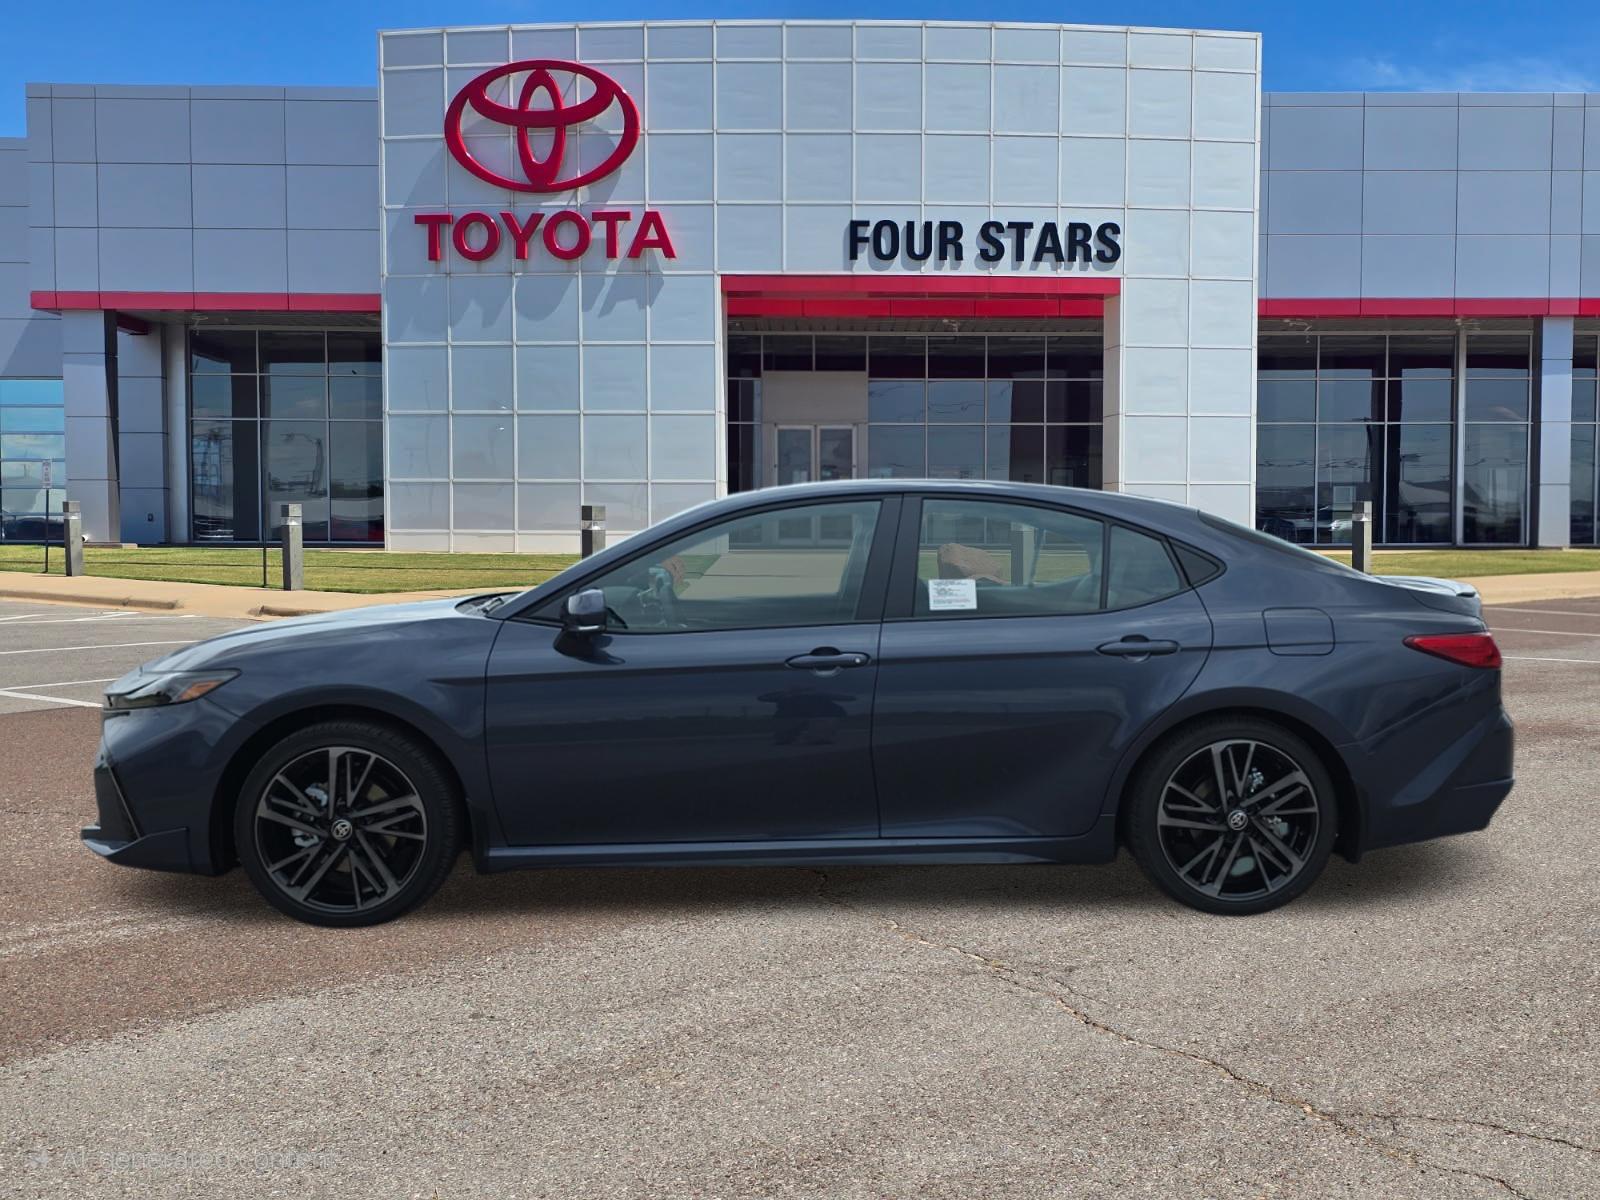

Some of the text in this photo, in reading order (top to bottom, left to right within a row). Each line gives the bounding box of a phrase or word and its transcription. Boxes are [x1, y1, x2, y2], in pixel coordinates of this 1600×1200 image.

[415, 210, 677, 262] TOYOTA
[849, 219, 1121, 263] FOUR STARS
